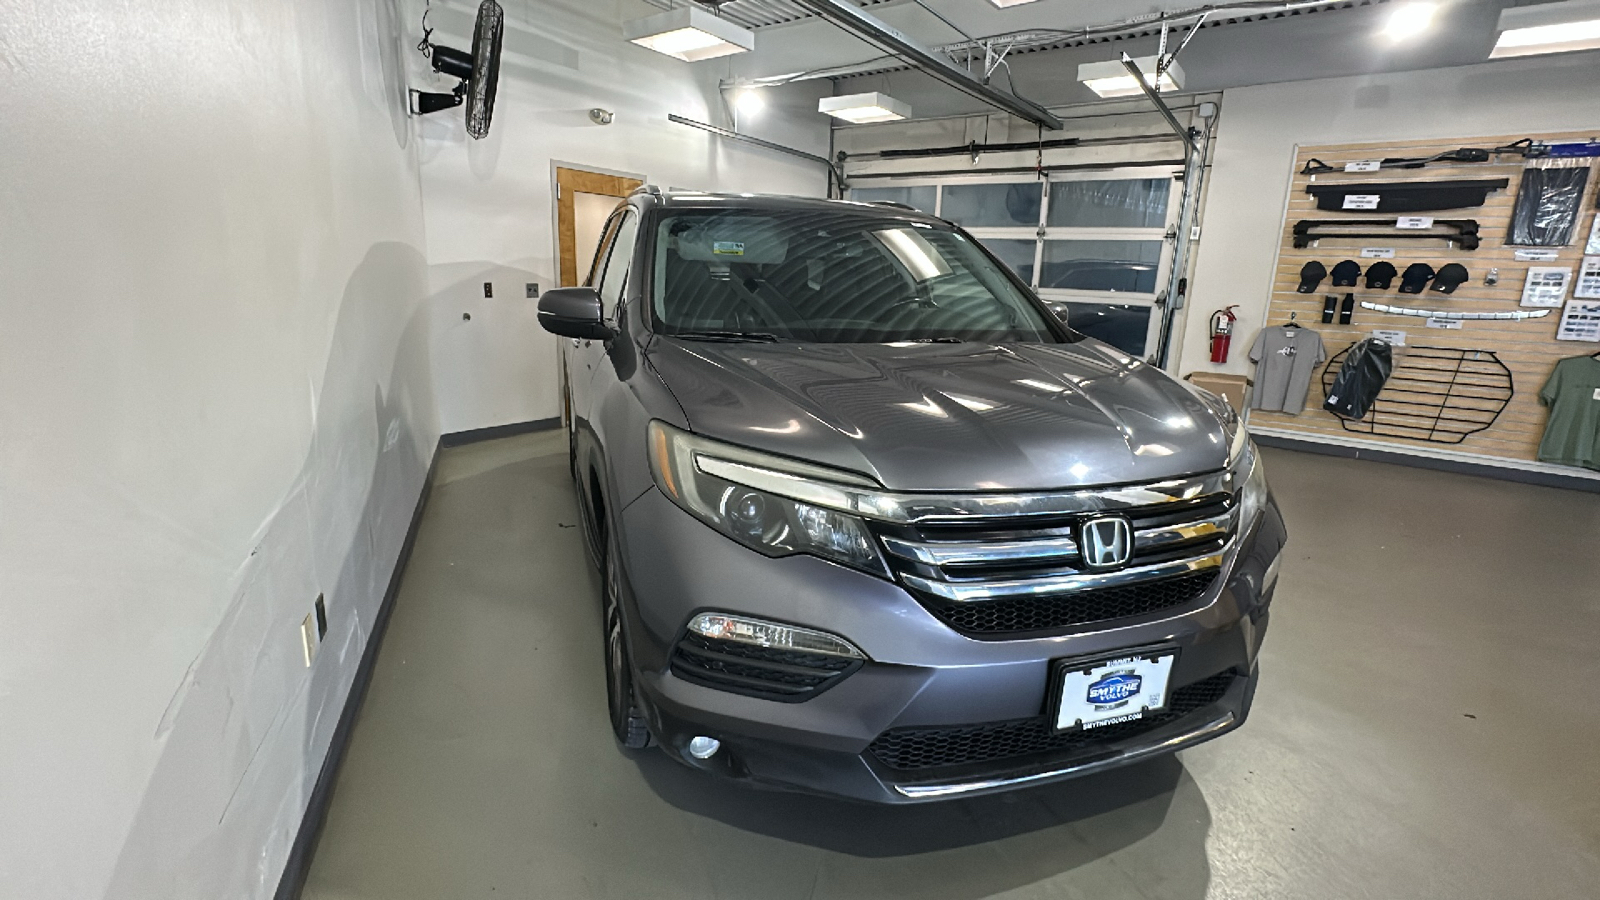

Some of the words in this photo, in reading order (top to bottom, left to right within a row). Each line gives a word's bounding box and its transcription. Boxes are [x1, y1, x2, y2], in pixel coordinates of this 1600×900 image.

[1089, 682, 1139, 698] SMYTHE
[1100, 691, 1129, 701] VOLVO
[1082, 712, 1143, 730] SMYTHEVOLVO.COM
